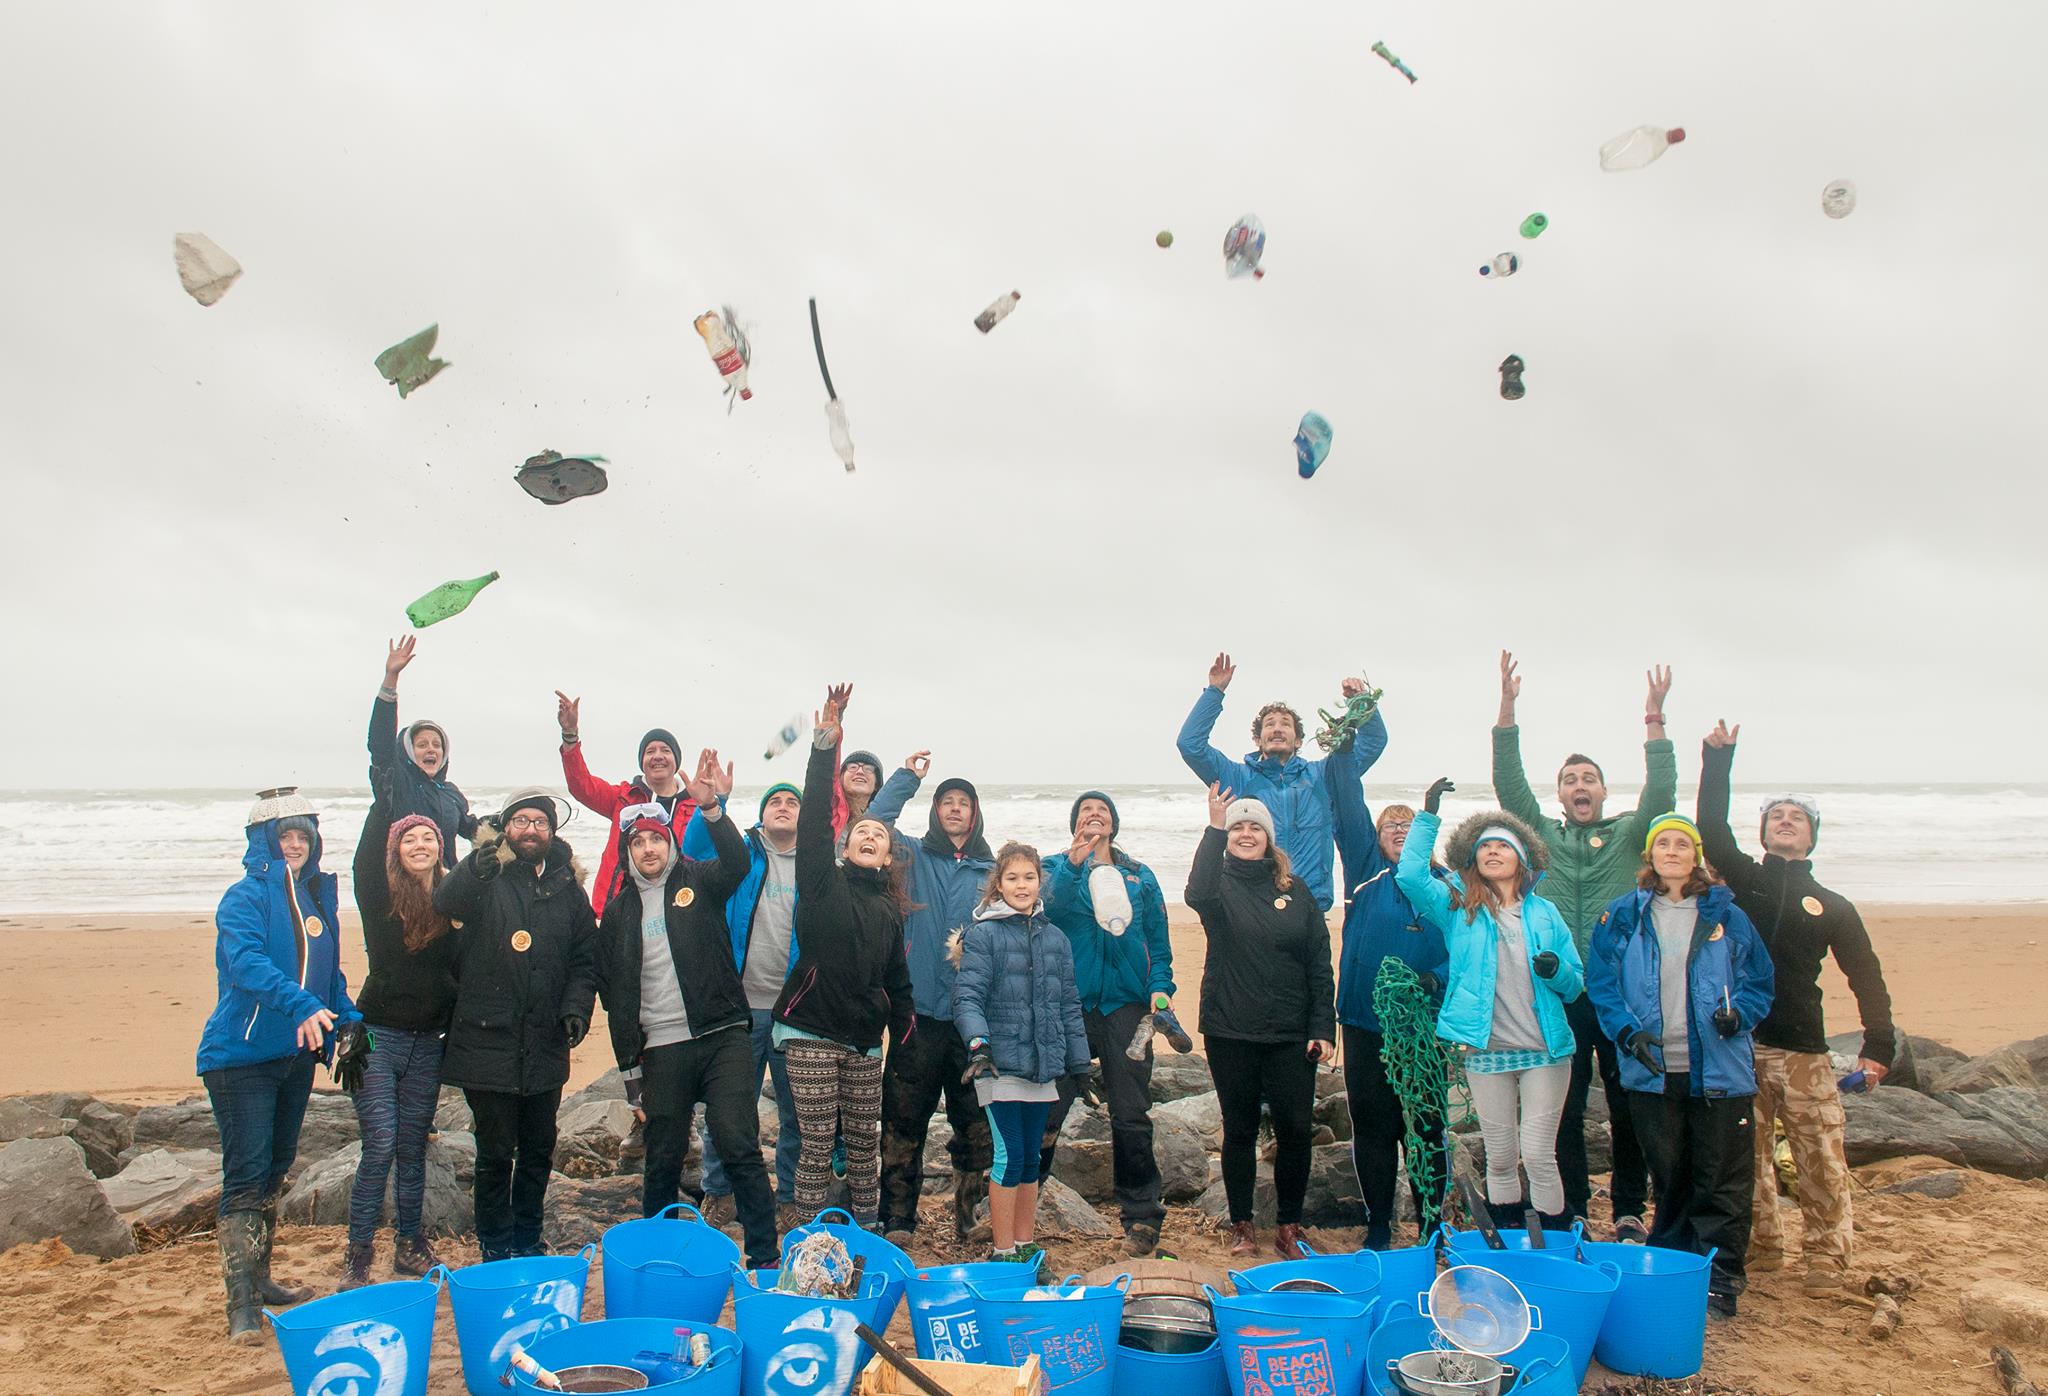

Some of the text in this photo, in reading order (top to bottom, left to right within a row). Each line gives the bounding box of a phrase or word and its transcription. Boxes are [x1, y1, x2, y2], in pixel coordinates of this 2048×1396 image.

[1267, 1351, 1324, 1372] BEACH
[1269, 1364, 1328, 1387] CLEAN
[1294, 1378, 1330, 1396] BOX
